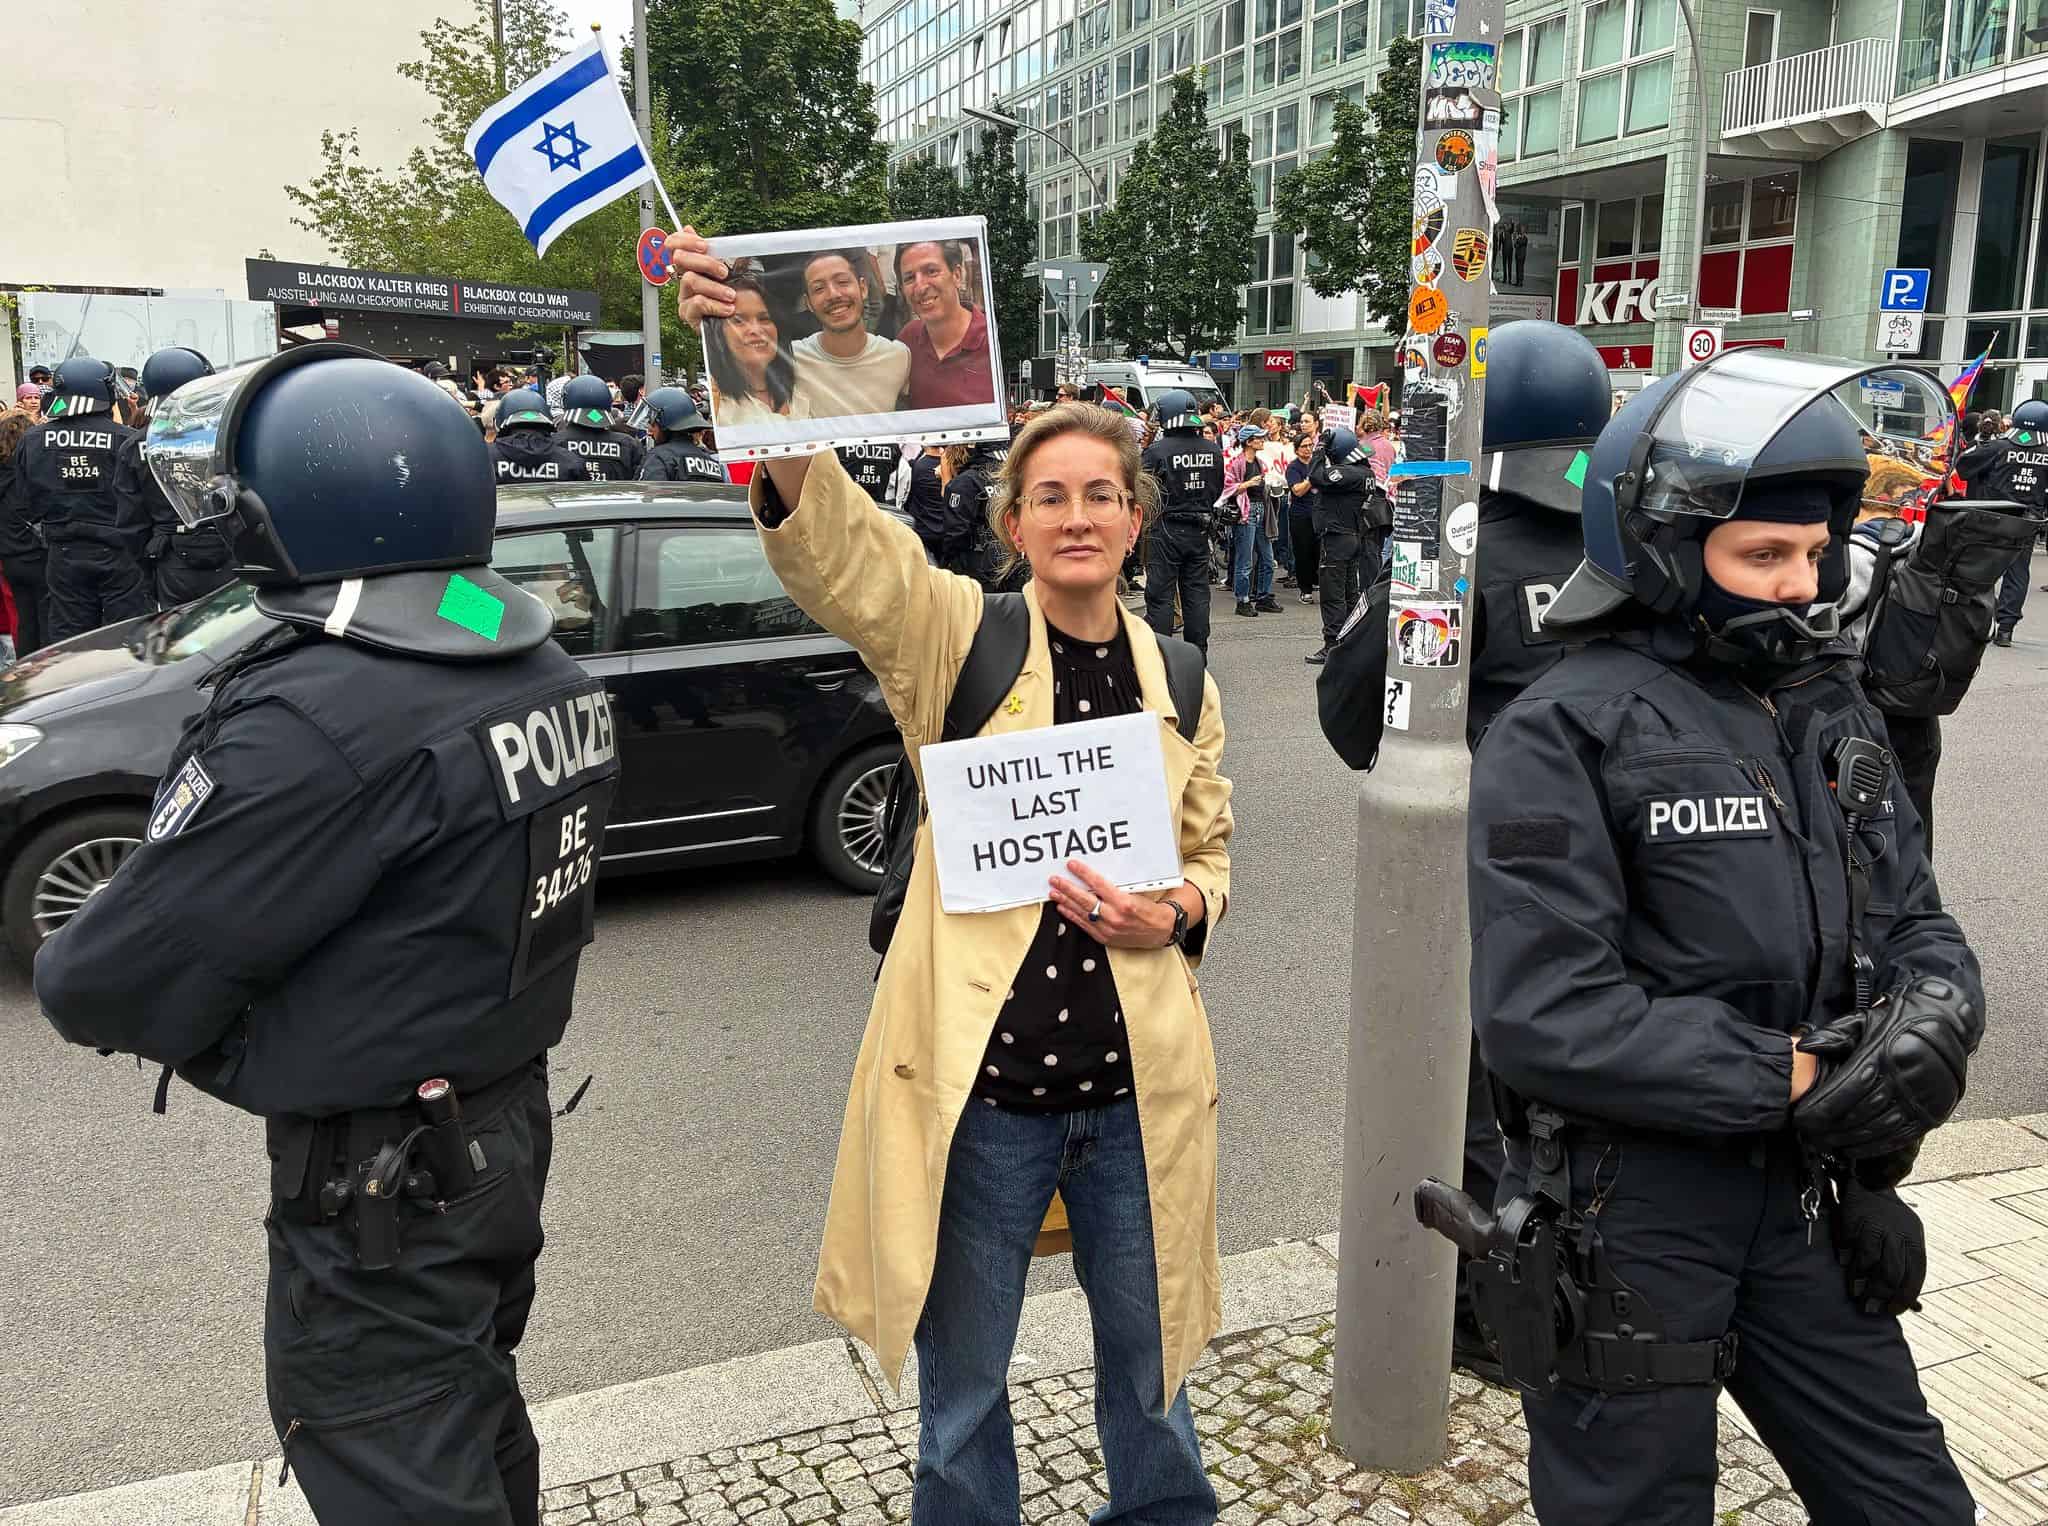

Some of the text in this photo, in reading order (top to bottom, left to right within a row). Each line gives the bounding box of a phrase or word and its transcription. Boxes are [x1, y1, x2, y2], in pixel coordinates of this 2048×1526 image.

[298, 271, 448, 297] BLACKBOX KALTER KRIEG
[1887, 274, 1914, 306] P
[267, 287, 449, 311] AUSSTELLUNG AM CHECKPOINT CHARLIE
[463, 286, 569, 307] BLACKBOX COLD WAR
[464, 302, 592, 321] EXHIBITION AT CHECKPOINT CHARLIE
[1694, 338, 1710, 353] 30
[1266, 356, 1292, 366] KFC
[45, 430, 112, 449] POLIZEI
[567, 440, 621, 457] POLIZEI
[70, 456, 88, 467] BE
[846, 445, 891, 460] POLIZEI
[1173, 453, 1214, 469] POLIZEI
[2007, 451, 2048, 466] POLIZE
[61, 467, 100, 479] 34324
[497, 460, 559, 479] POLIZEI
[585, 461, 600, 472] BE
[686, 457, 721, 477] POLIZE
[864, 465, 876, 474] BE
[2021, 468, 2033, 476] BE
[489, 691, 614, 804] POLIZEI
[967, 745, 1115, 789] UNTIL THE
[1011, 787, 1081, 821] LAST
[1650, 795, 1769, 836] POLIZEI
[559, 805, 588, 858] BE
[973, 820, 1132, 872] HOSTAGE
[531, 844, 594, 919] 34126
